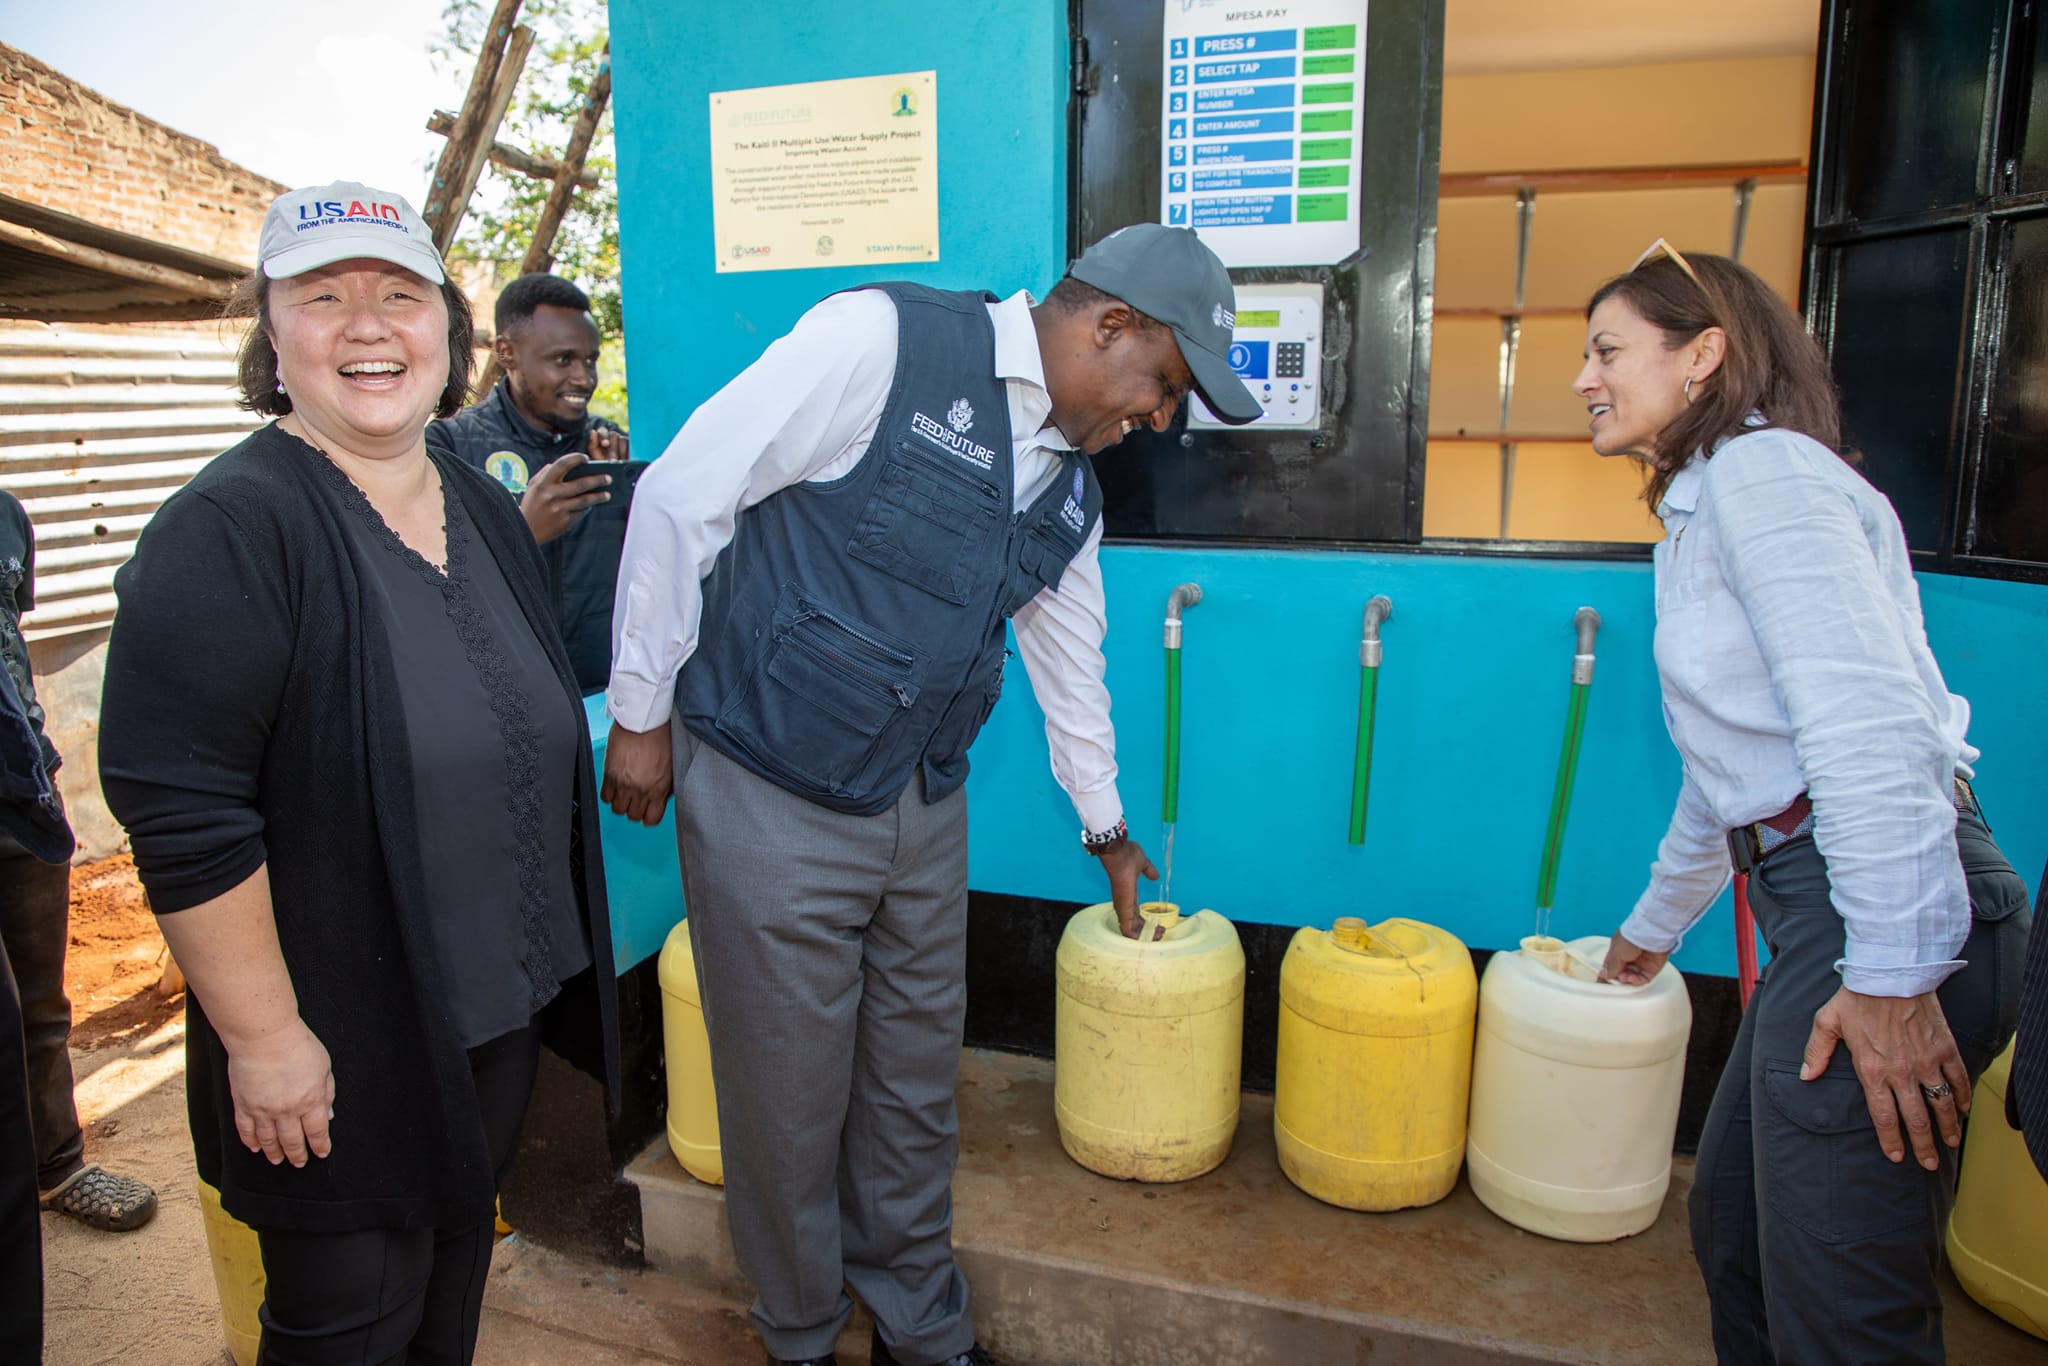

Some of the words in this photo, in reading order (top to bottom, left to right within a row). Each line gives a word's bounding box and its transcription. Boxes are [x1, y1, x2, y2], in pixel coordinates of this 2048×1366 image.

[1226, 10, 1263, 21] MPESA
[1266, 8, 1288, 17] PAY
[1175, 41, 1184, 55] 1
[1203, 38, 1244, 52] PRESS
[1246, 37, 1256, 48] #
[1175, 69, 1184, 83] 2
[1198, 65, 1237, 77] SELECT
[1239, 62, 1260, 74] TAP
[1173, 97, 1183, 111] 3
[1198, 89, 1224, 98] ENTER
[1226, 87, 1255, 96] MPESA
[1197, 100, 1234, 110] NUMBER
[1172, 124, 1183, 138] 4
[1197, 122, 1223, 131] ENTER
[1224, 119, 1261, 129] AMOUNT
[734, 142, 748, 150] The
[780, 138, 811, 146] Multiple
[832, 134, 857, 142] Water
[860, 131, 887, 142] Supply
[890, 130, 921, 139] Project
[1174, 146, 1183, 160] 5
[1197, 146, 1220, 154] PRESS
[1172, 174, 1183, 187] 6
[1173, 204, 1183, 219] 7
[297, 220, 320, 232] FROM
[321, 217, 335, 226] THE
[744, 246, 771, 255] USAID
[912, 411, 944, 438] FEED
[946, 430, 995, 464] FUTURE
[1064, 494, 1085, 527] USAID
